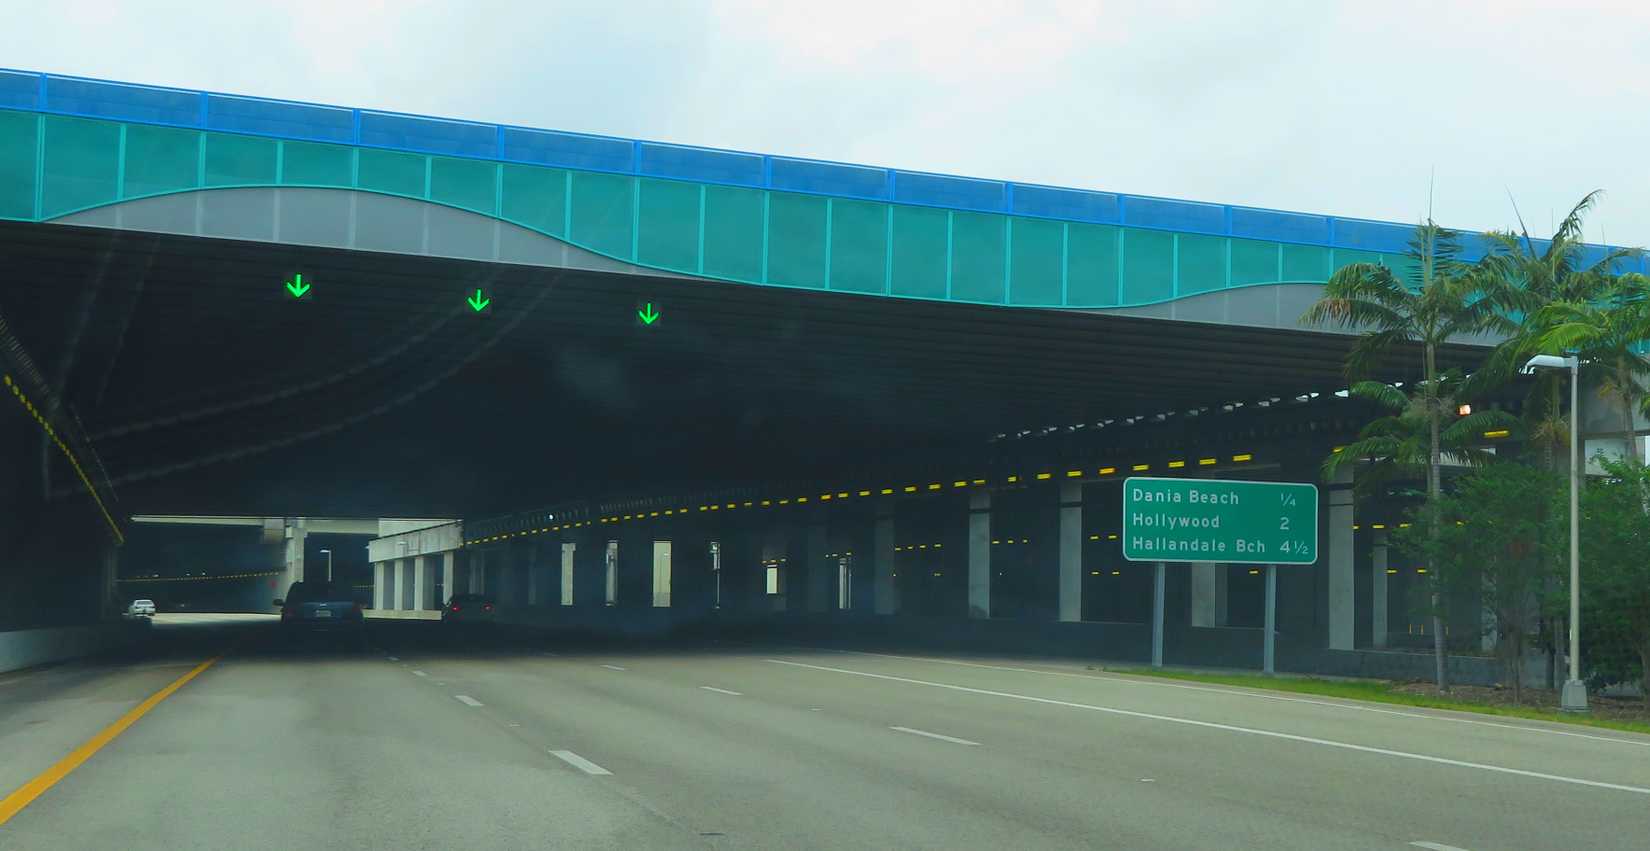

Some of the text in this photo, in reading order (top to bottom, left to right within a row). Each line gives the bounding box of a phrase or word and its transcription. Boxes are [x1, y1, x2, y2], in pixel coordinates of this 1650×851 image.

[1133, 488, 1182, 503] Dania
[1189, 489, 1240, 505] Beach
[1132, 512, 1290, 530] Hollywood 2
[1132, 536, 1227, 552] Hallandale
[1235, 538, 1266, 553] Bch
